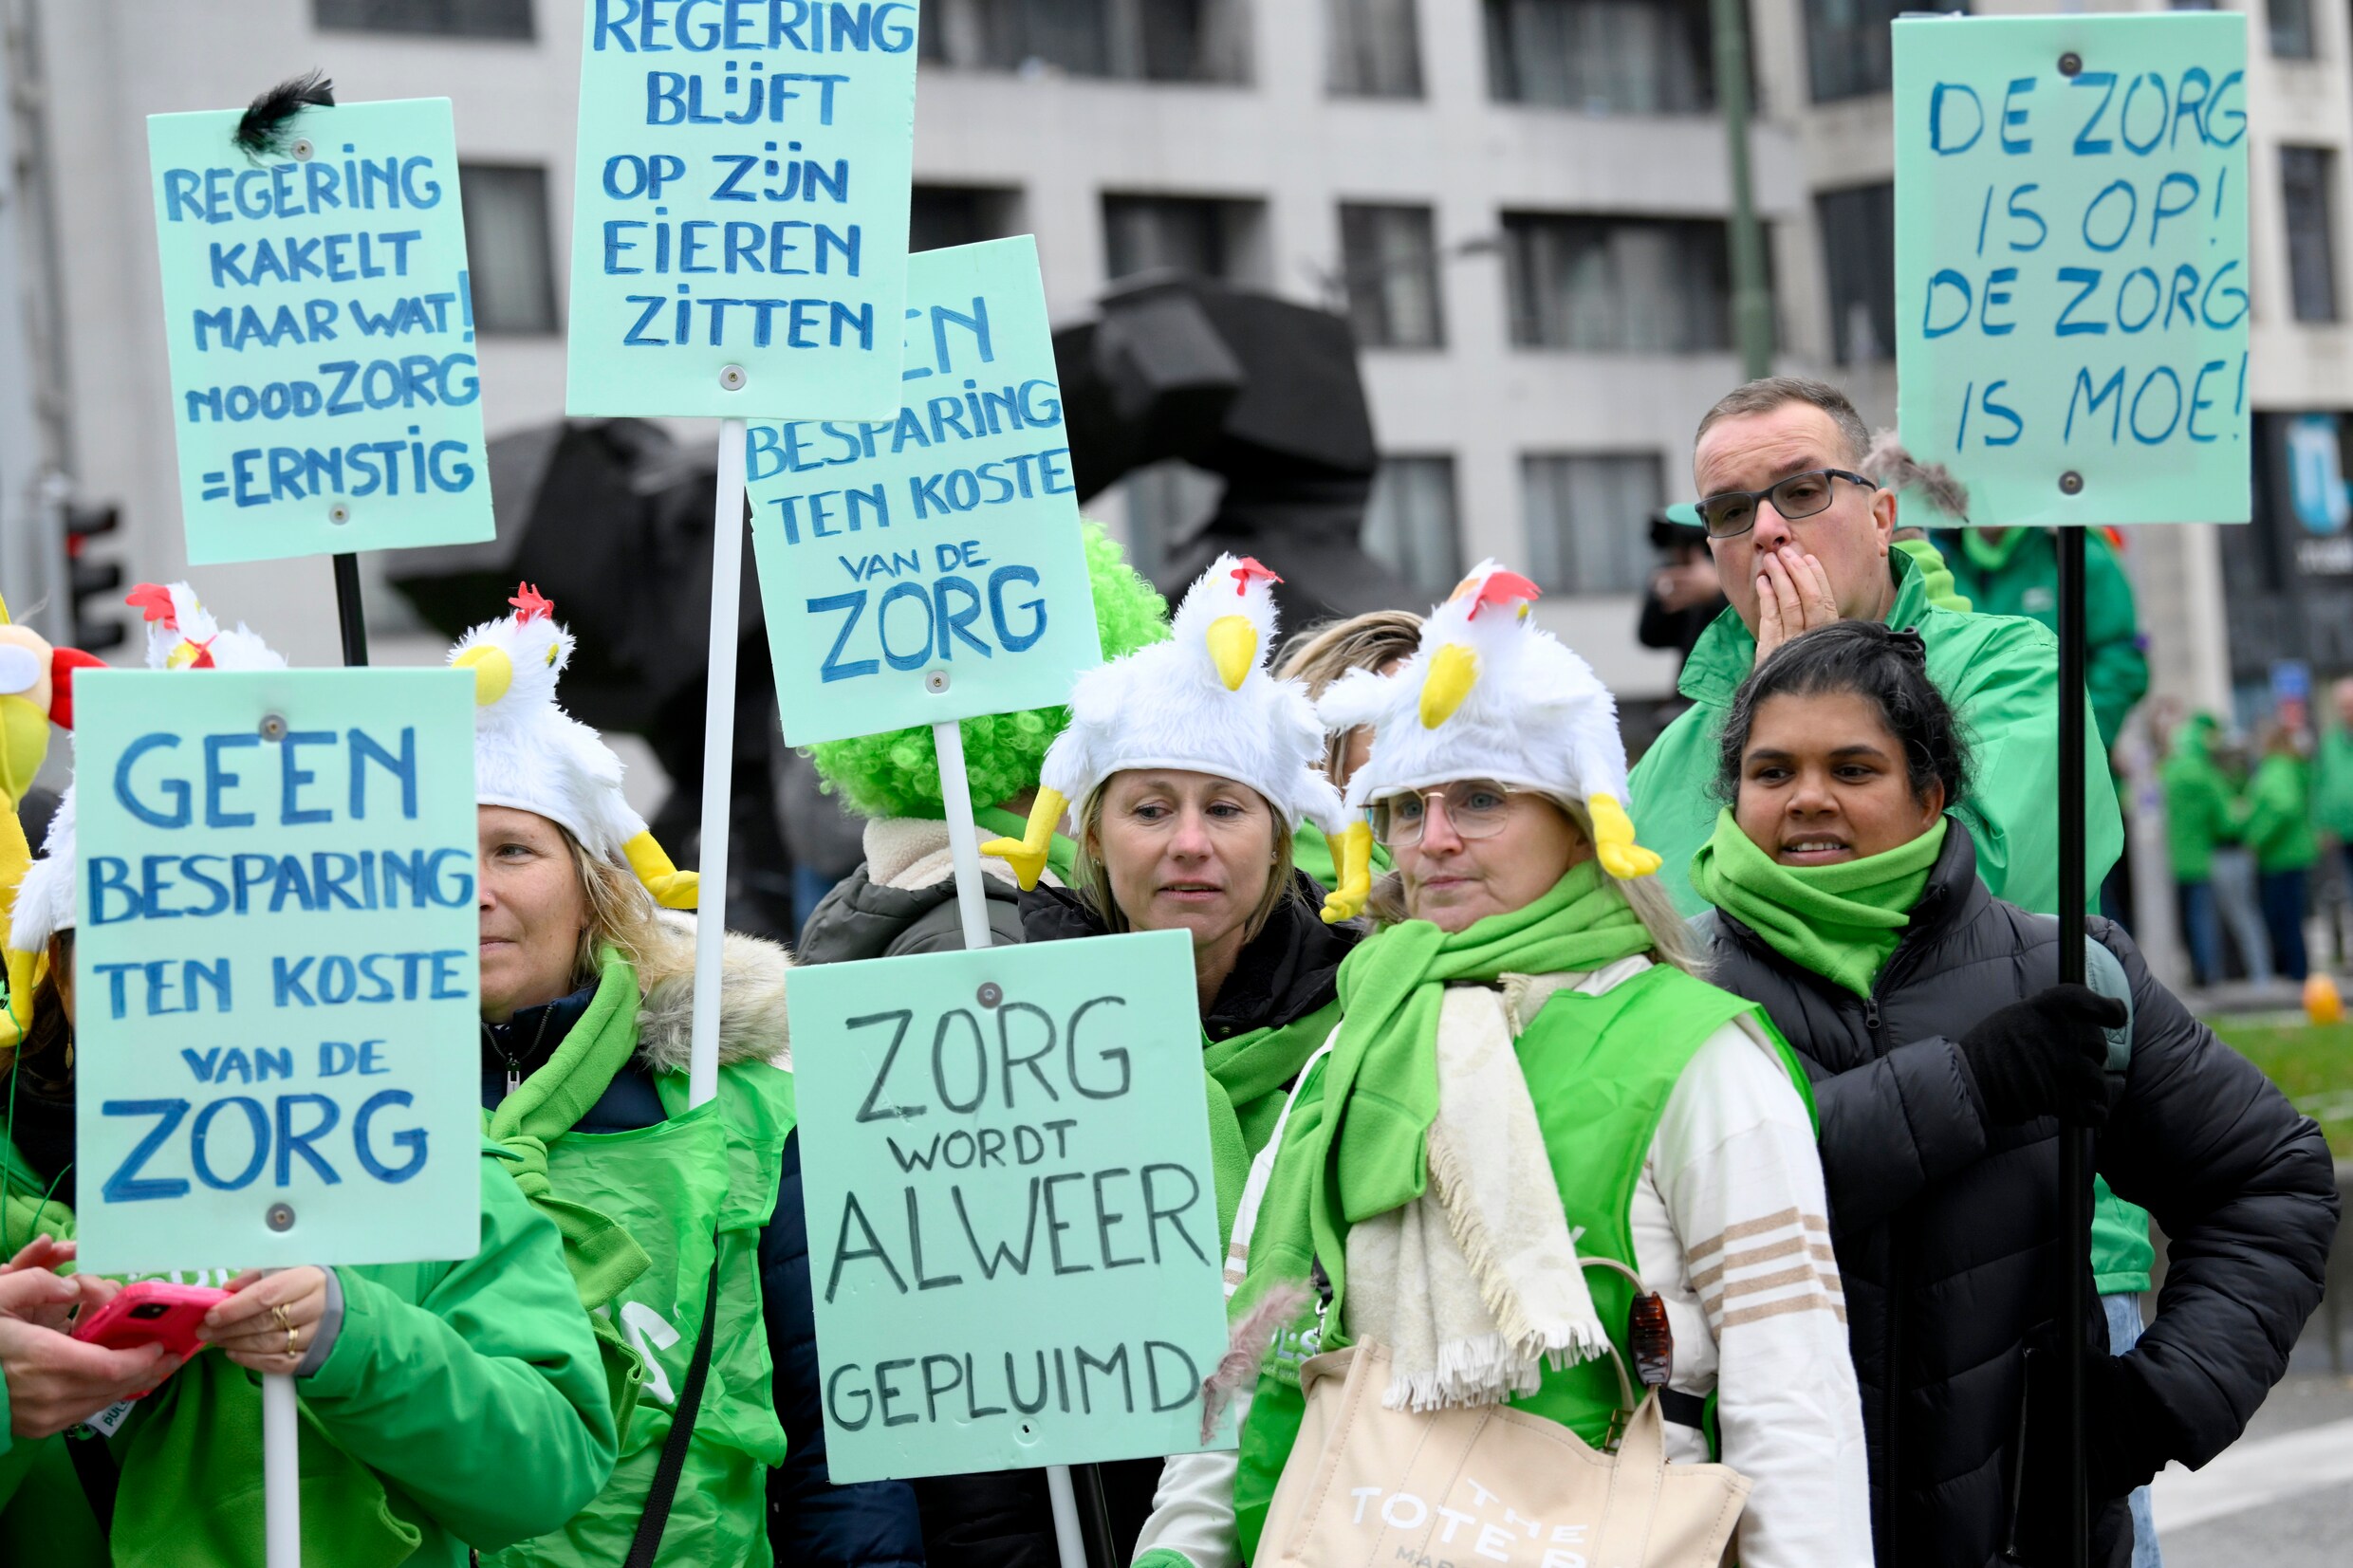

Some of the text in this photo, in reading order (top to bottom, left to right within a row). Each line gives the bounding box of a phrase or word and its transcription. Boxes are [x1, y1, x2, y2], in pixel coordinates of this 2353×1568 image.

[594, 0, 917, 54] REGERING
[646, 61, 851, 126] BLIJFT
[1929, 66, 2248, 157] DE ZORG
[163, 143, 442, 225] REGERING
[602, 141, 850, 204] OP ZIJN
[1976, 165, 2227, 258] IS OP!
[210, 230, 423, 288] KAKELT
[603, 206, 862, 277] EIEREN
[193, 270, 475, 352] MAAR WAT!
[622, 283, 875, 351] ZITTEN
[1922, 259, 2250, 340] DE ZORG
[185, 353, 481, 423] NOODZORG
[1956, 350, 2249, 455] IS MOE!
[745, 379, 1063, 483] BESPARING
[768, 448, 1076, 546] TEN KOSTE
[838, 540, 991, 582] VAN DE
[806, 564, 1048, 683] ZORG
[114, 727, 418, 829] GEEN
[87, 847, 473, 927] BESPARING
[93, 949, 470, 1020] TEN KOSTE
[180, 1039, 392, 1085] VAN DE
[845, 995, 1132, 1123] ZORG
[102, 1088, 429, 1204] ZORG
[886, 1118, 1078, 1173] WORDT
[824, 1162, 1211, 1304] ALWEER
[826, 1339, 1201, 1432] GEPLUIMD
[1350, 1486, 1516, 1563] TOTE
[1467, 1477, 1588, 1540] THE
